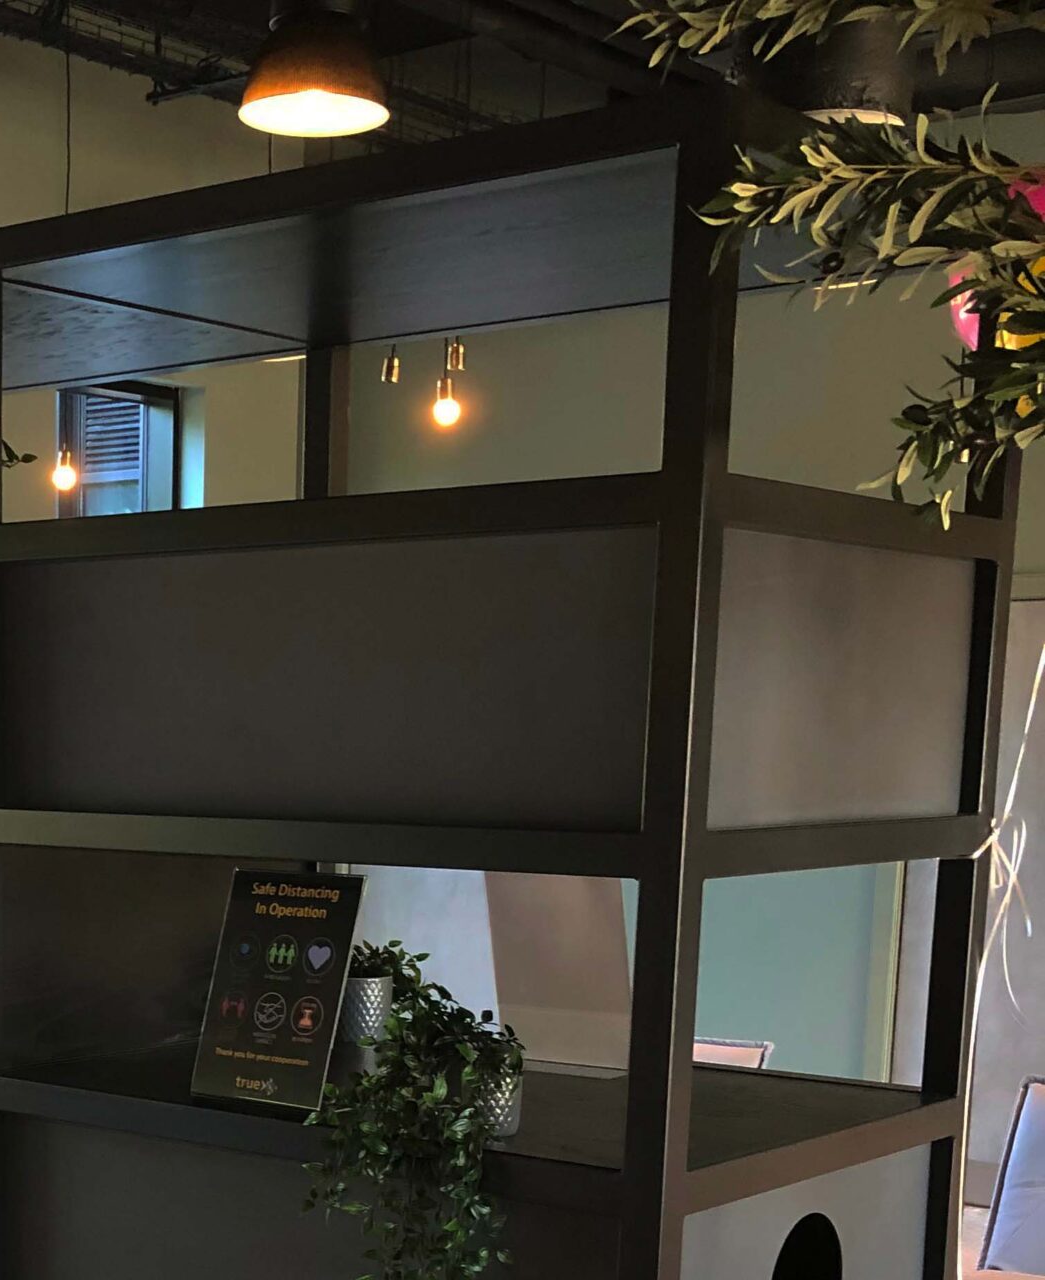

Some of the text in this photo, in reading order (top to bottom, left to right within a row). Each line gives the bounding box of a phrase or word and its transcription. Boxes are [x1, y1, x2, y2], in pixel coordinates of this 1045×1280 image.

[252, 882, 340, 903] Safe Distancing
[255, 902, 328, 919] In Operation
[236, 1076, 261, 1090] true
